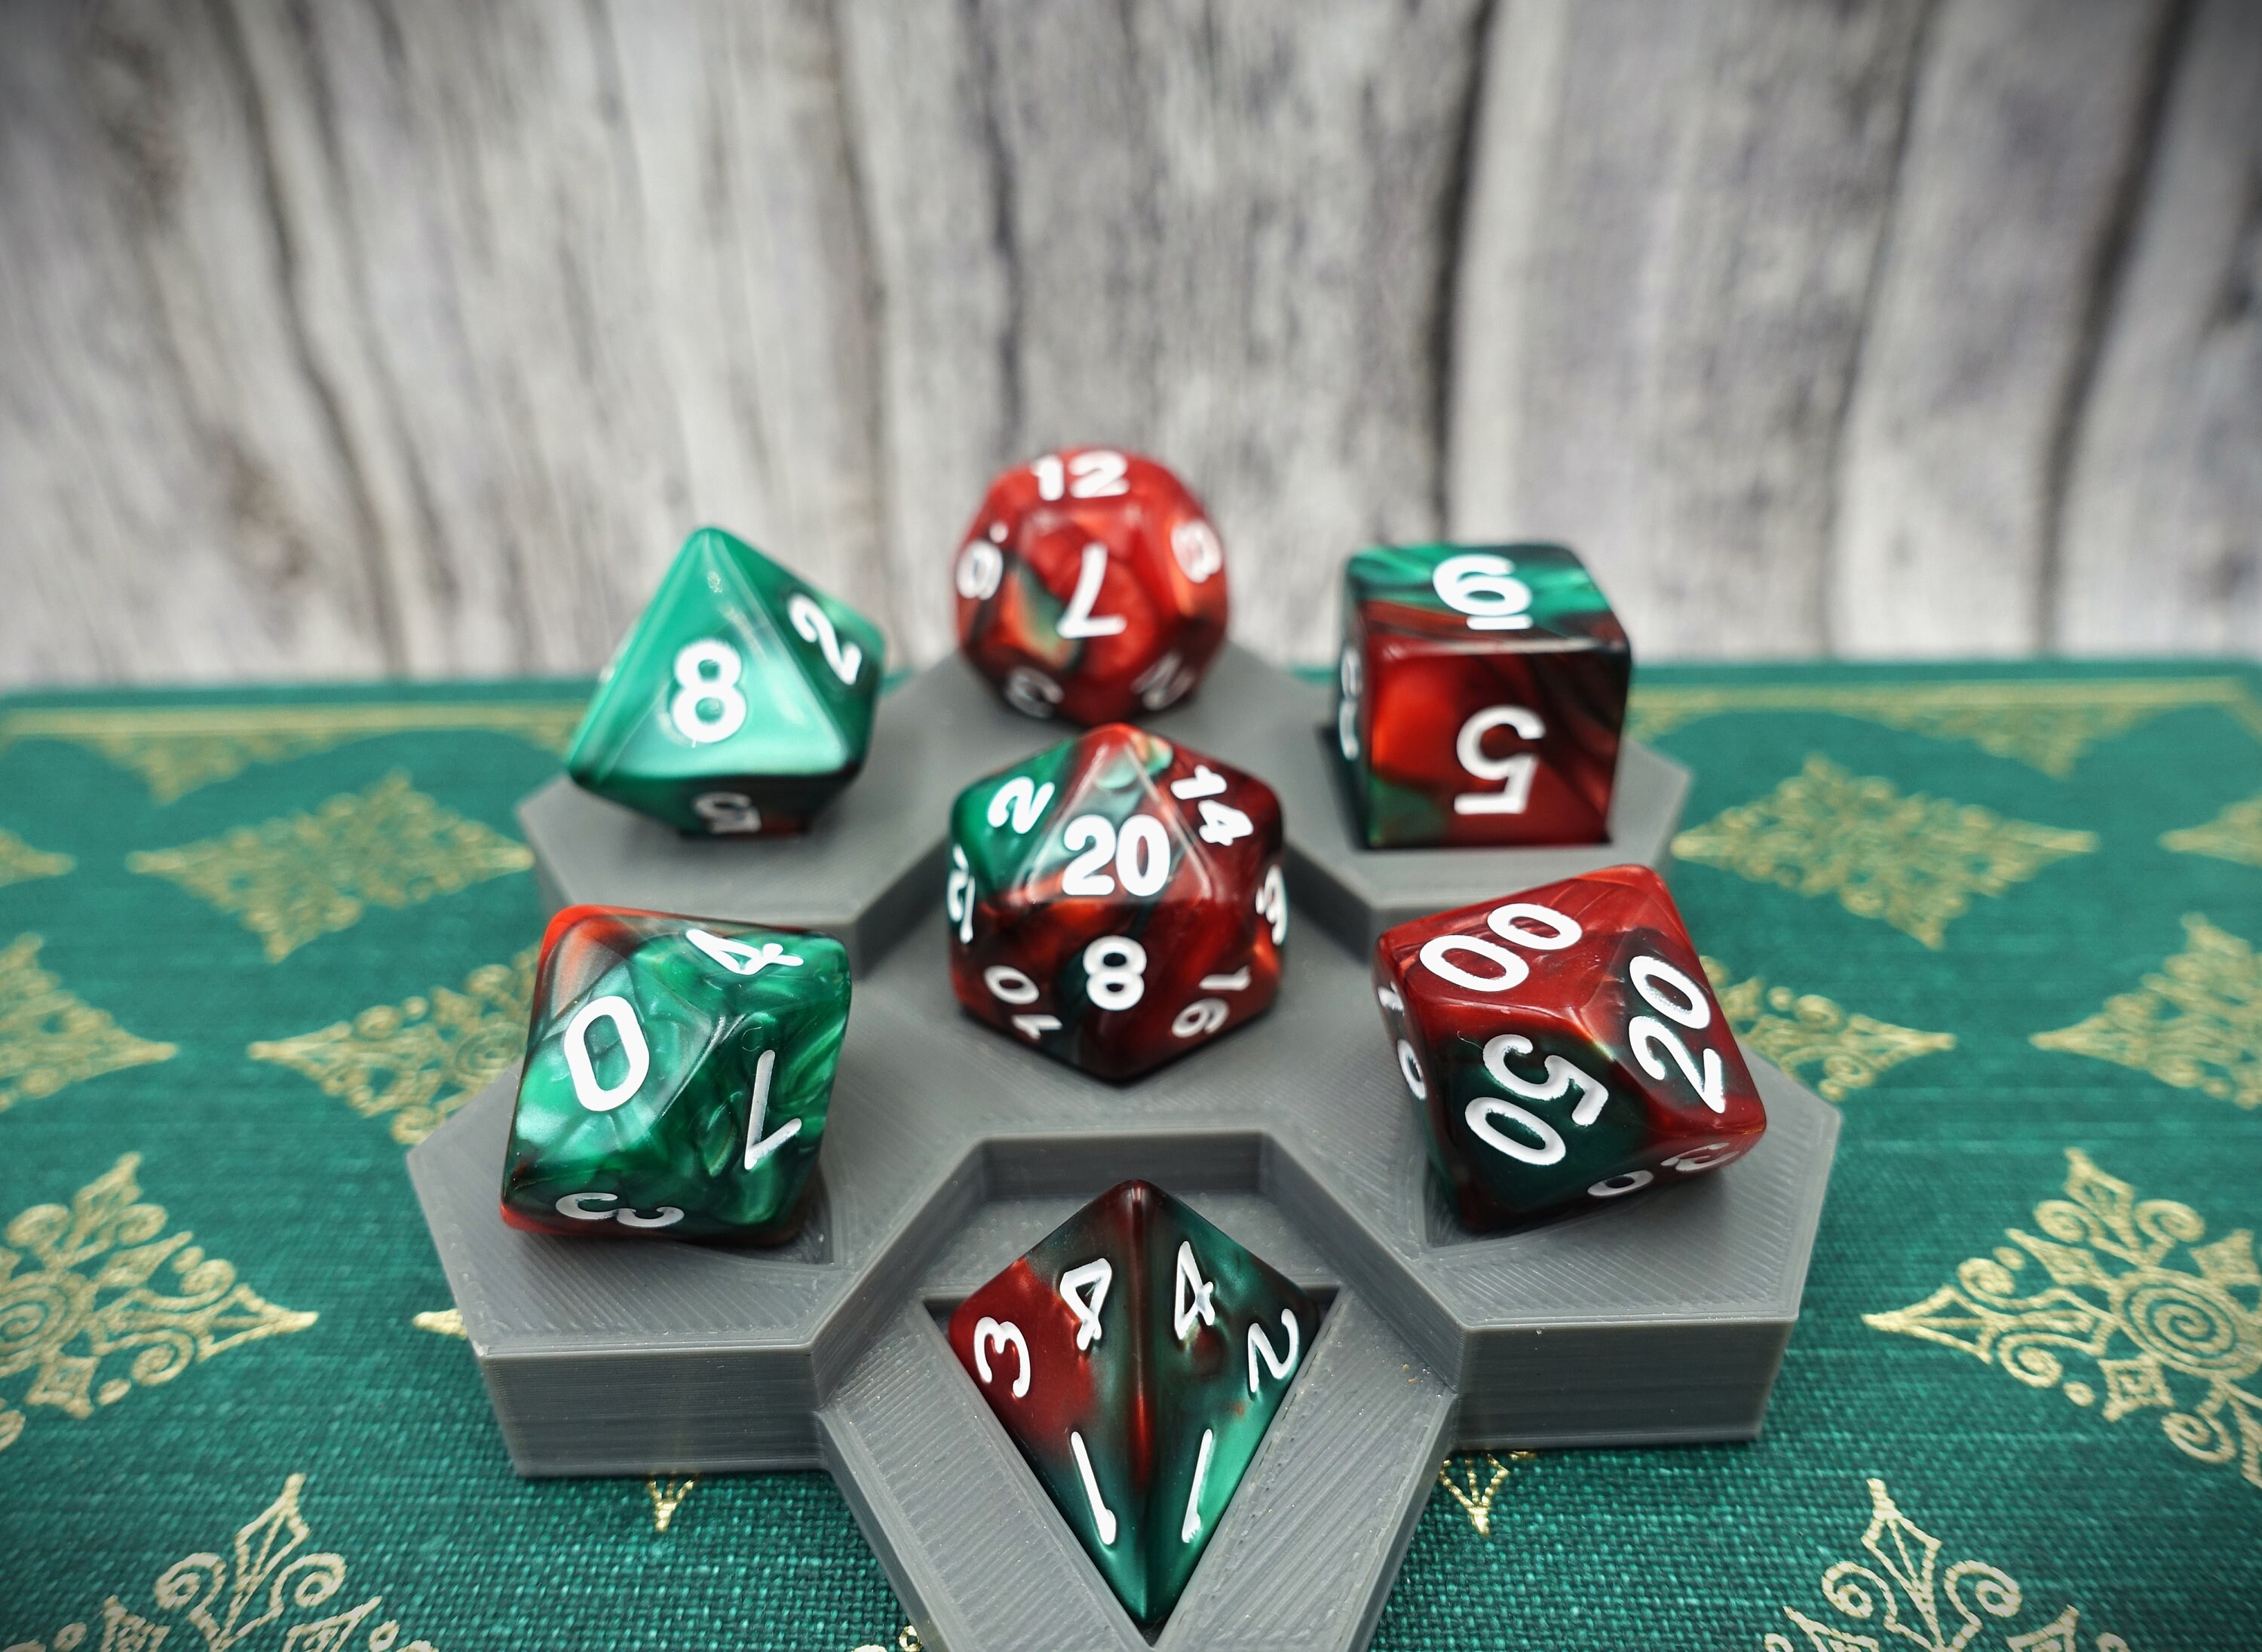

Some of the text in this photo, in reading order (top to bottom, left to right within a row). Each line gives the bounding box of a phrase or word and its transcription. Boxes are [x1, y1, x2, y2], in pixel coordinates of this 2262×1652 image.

[1031, 450, 1129, 501] 12
[1057, 543, 1127, 639] 7
[788, 592, 862, 685] 2
[670, 637, 747, 746] 8
[987, 776, 1055, 834] 2
[1454, 705, 1546, 815] 5
[1170, 765, 1254, 846] 14
[1062, 814, 1171, 896] 20
[685, 929, 804, 975] 4
[1083, 936, 1147, 1010] 8
[1419, 903, 1583, 992] 00
[984, 965, 1062, 1039] 10
[1171, 965, 1251, 1038] 16
[1629, 955, 1725, 1114] 20
[564, 996, 649, 1111] 0
[744, 1050, 802, 1170] 7
[1465, 1034, 1608, 1166] 50
[1587, 1142, 1739, 1198] 30
[1059, 1258, 1112, 1350] 4
[1174, 1240, 1215, 1341] 4
[974, 1316, 1031, 1398] 3
[1247, 1308, 1299, 1393] 2
[1071, 1431, 1116, 1546] 1
[1182, 1428, 1213, 1543] 1
